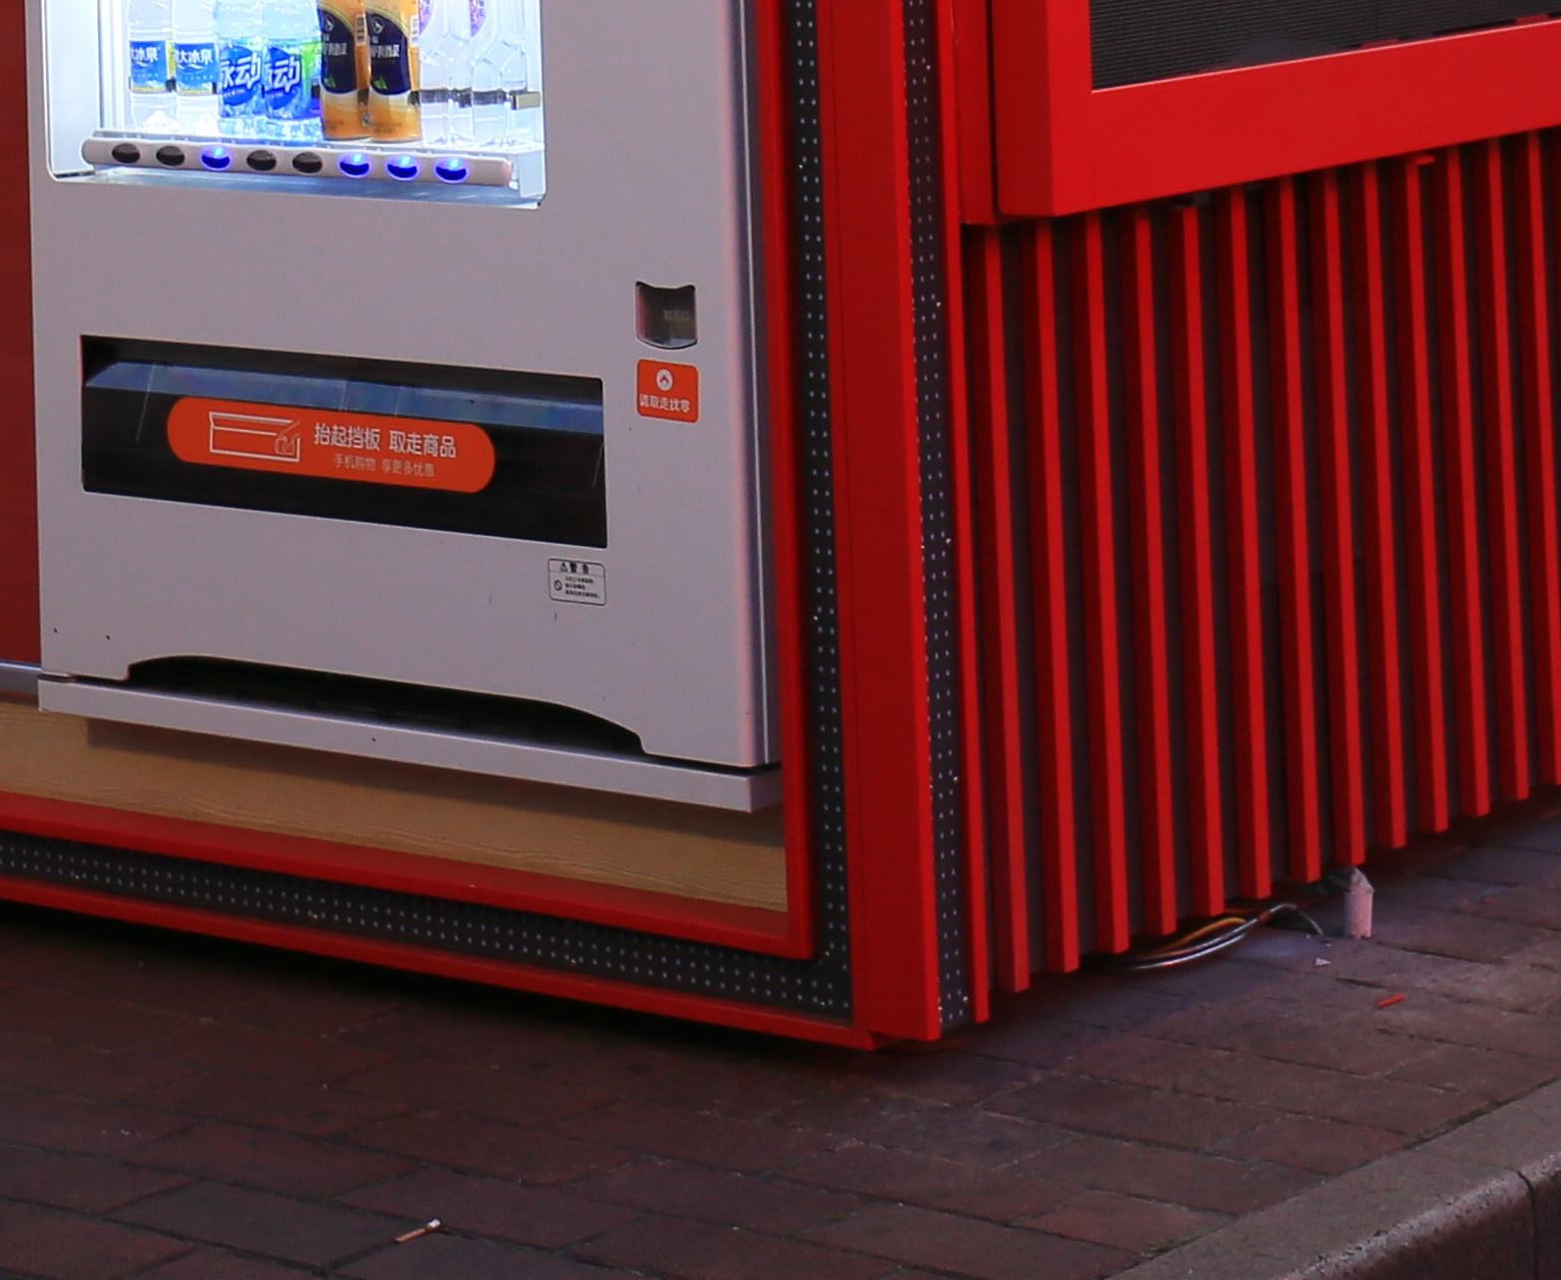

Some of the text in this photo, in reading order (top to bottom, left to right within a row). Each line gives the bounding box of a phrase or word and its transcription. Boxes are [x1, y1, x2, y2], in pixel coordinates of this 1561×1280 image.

[314, 422, 456, 459] 抬起挡板 取走商品
[334, 453, 376, 471] 手机购物
